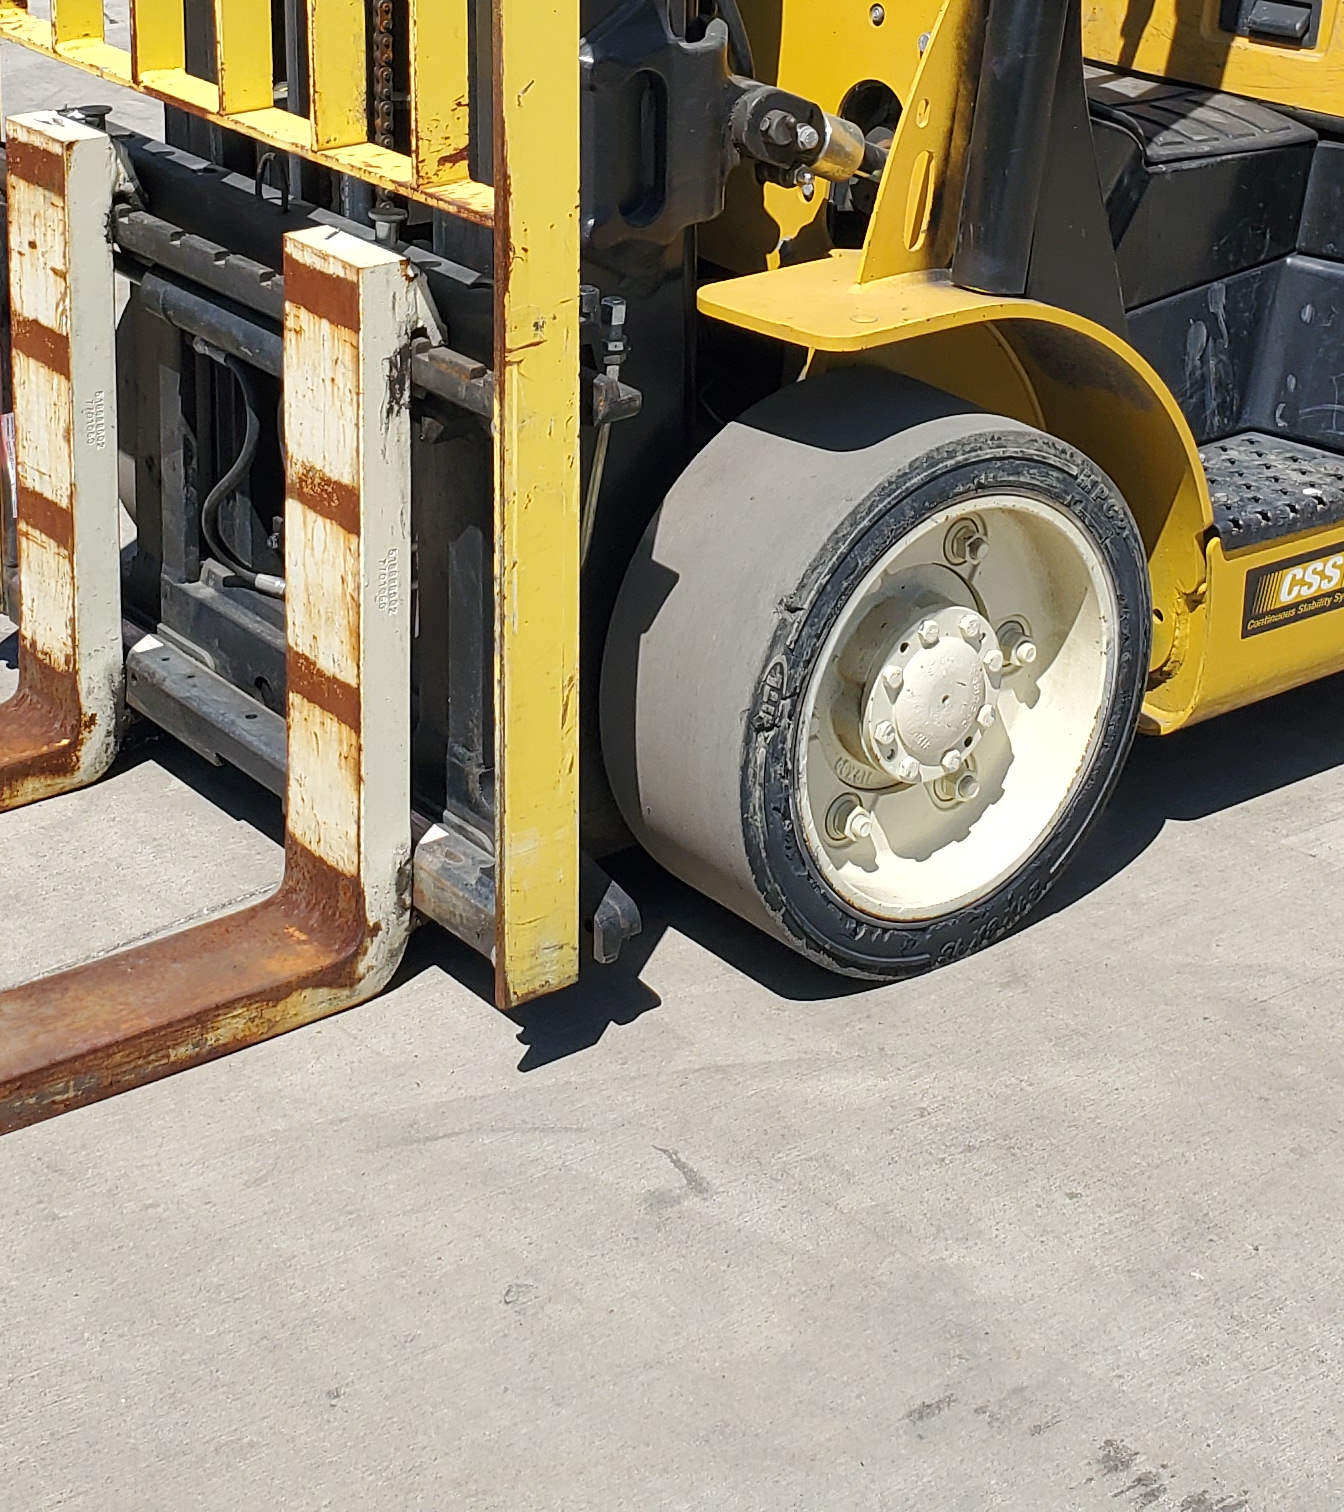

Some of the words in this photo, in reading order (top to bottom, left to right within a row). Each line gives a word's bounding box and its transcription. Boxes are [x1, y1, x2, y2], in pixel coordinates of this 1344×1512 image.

[1280, 555, 1344, 603] CSS
[1247, 609, 1296, 630] Continuous
[1297, 596, 1333, 614] Stability
